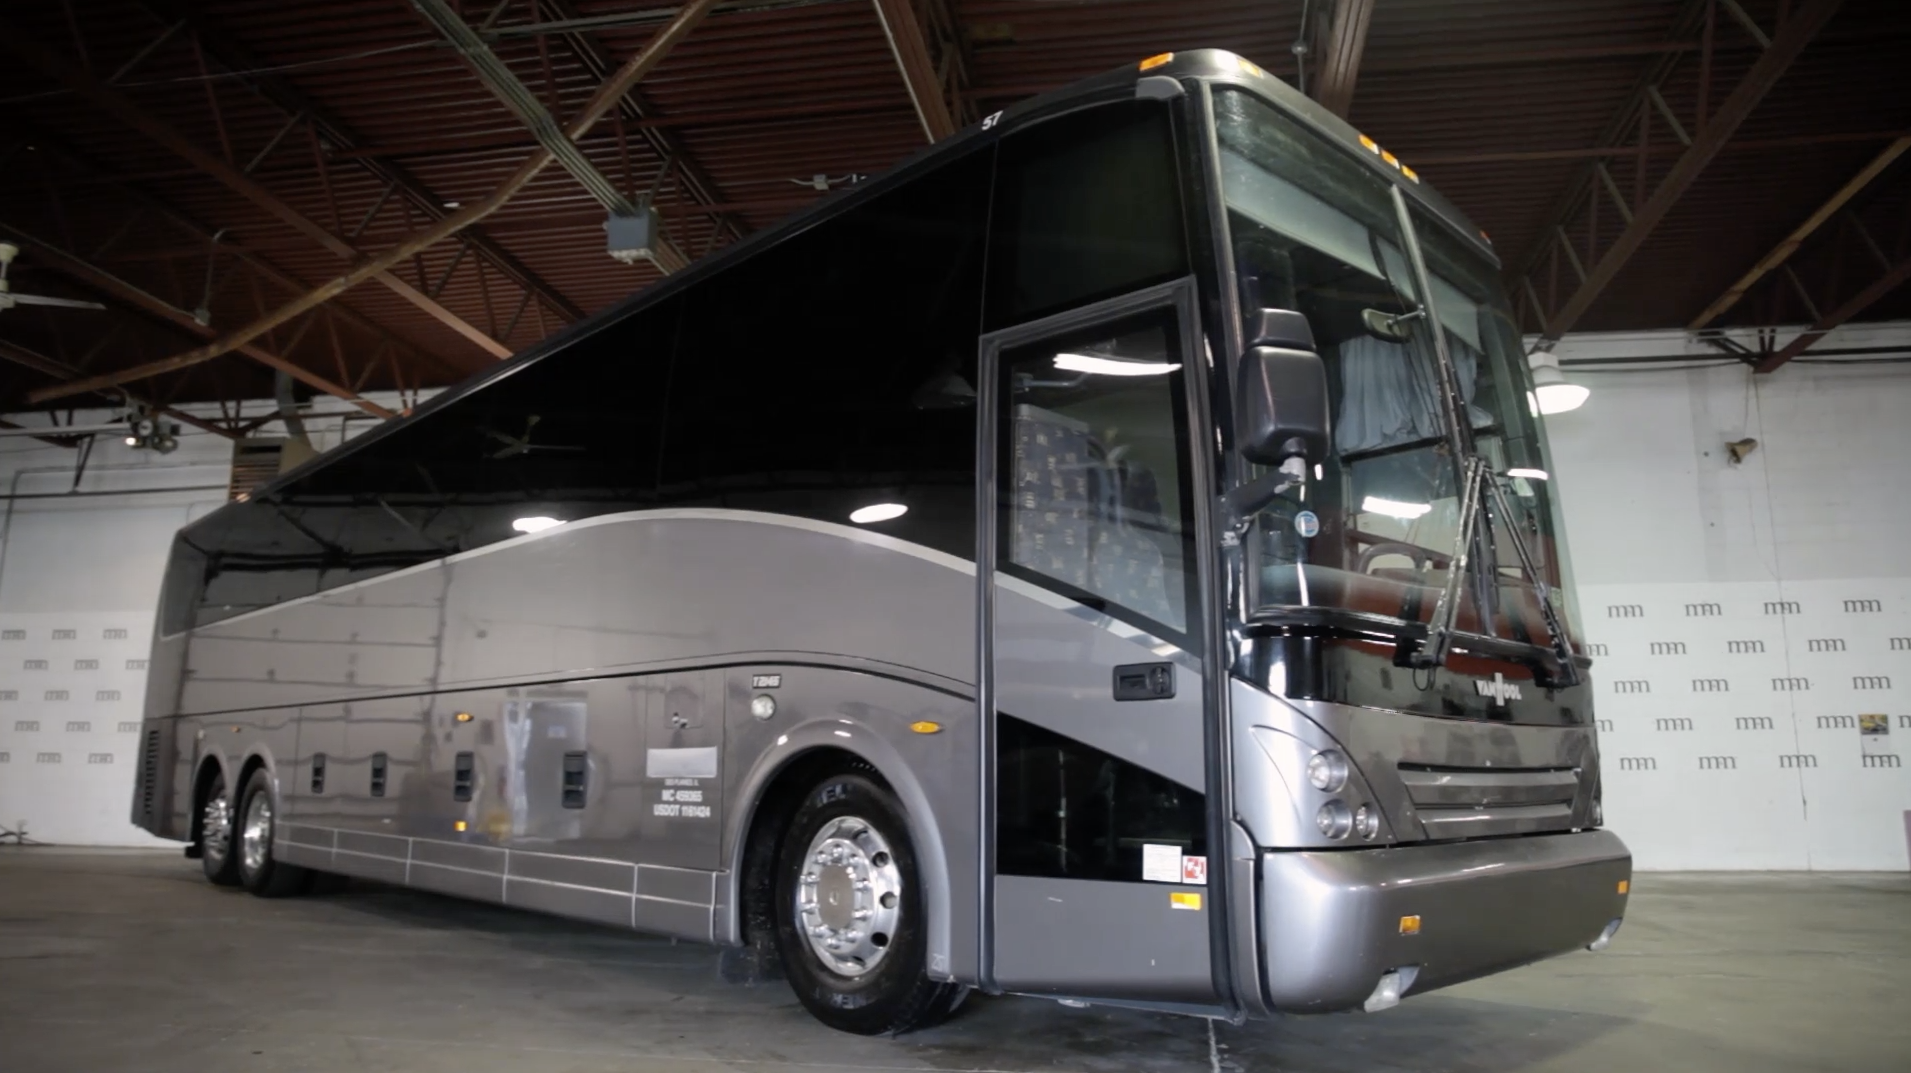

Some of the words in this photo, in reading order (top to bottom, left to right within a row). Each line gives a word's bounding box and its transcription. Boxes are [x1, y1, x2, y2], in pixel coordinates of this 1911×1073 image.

[981, 110, 1004, 131] 57
[661, 789, 676, 802] MC
[653, 804, 681, 817] USDOT
